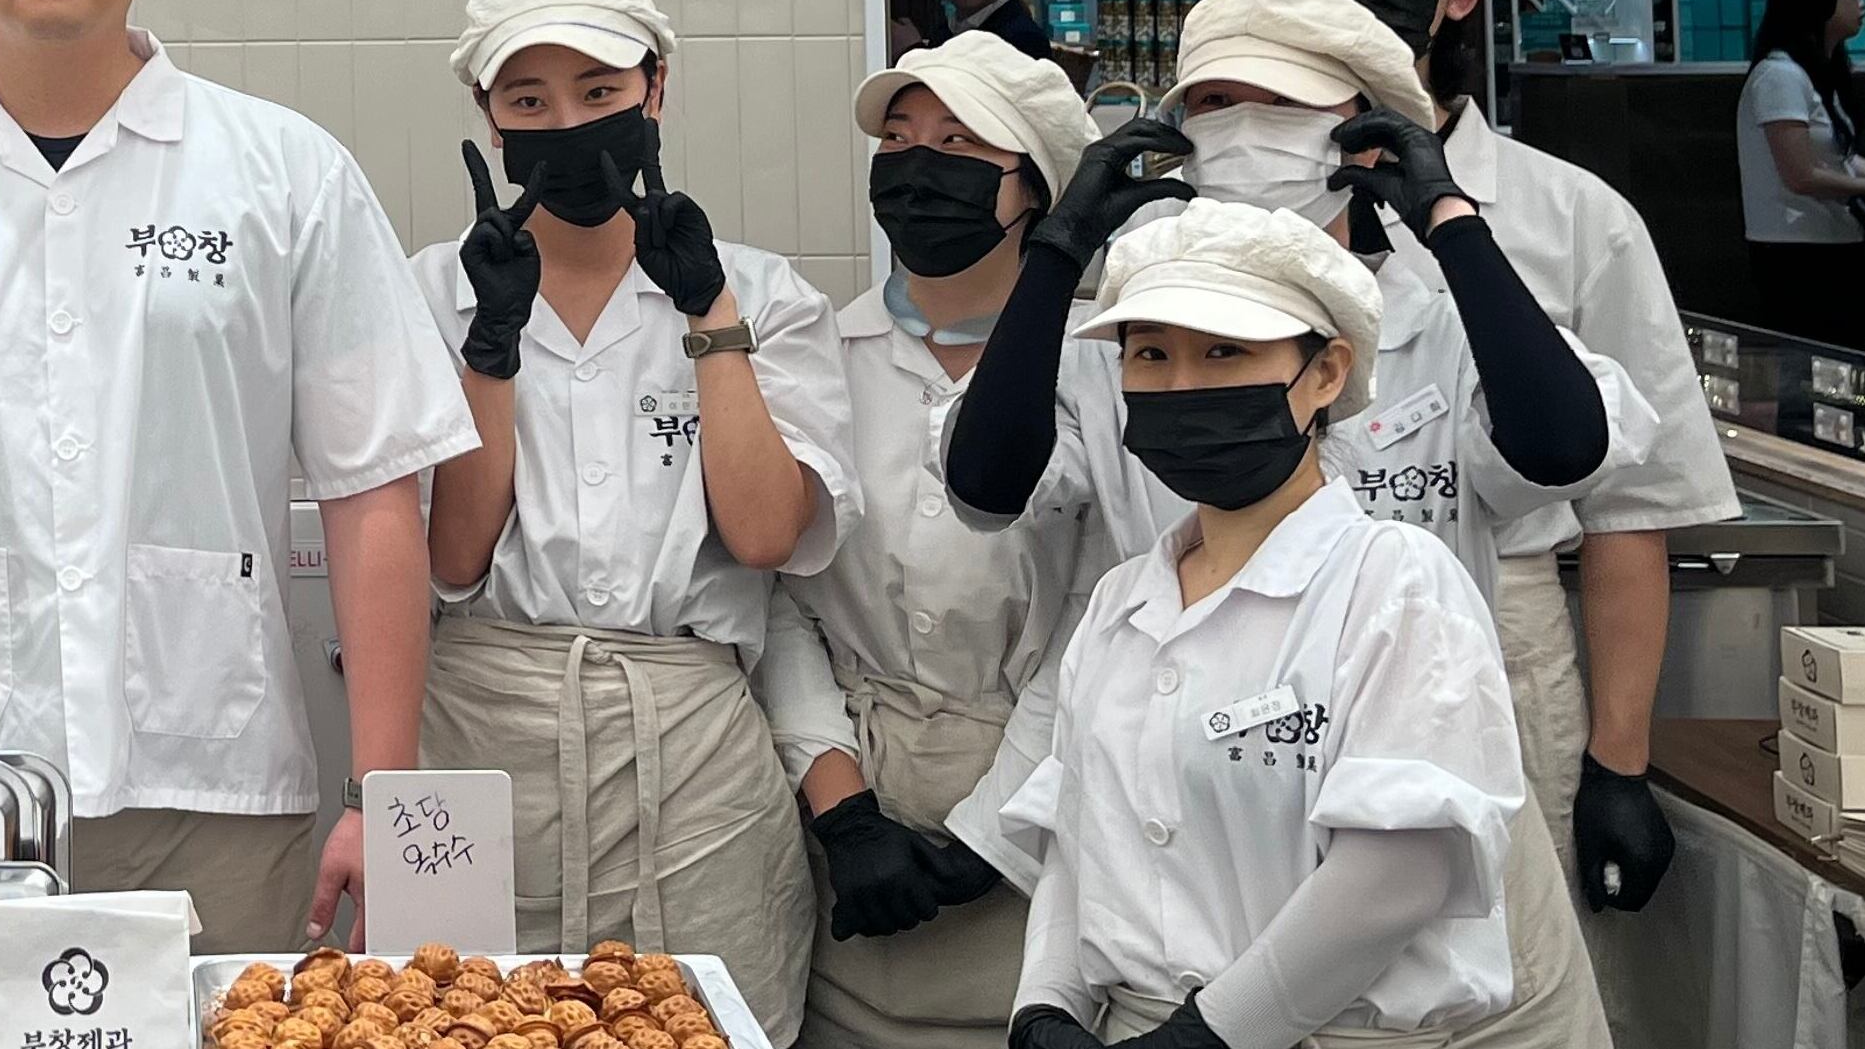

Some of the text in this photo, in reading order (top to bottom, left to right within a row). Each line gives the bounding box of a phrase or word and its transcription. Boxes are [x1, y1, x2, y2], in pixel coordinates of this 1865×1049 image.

[125, 223, 234, 265] 부 창
[649, 416, 682, 447] 부
[1353, 468, 1388, 501] 부
[388, 792, 449, 838] 초당
[403, 835, 475, 875] 옥수수
